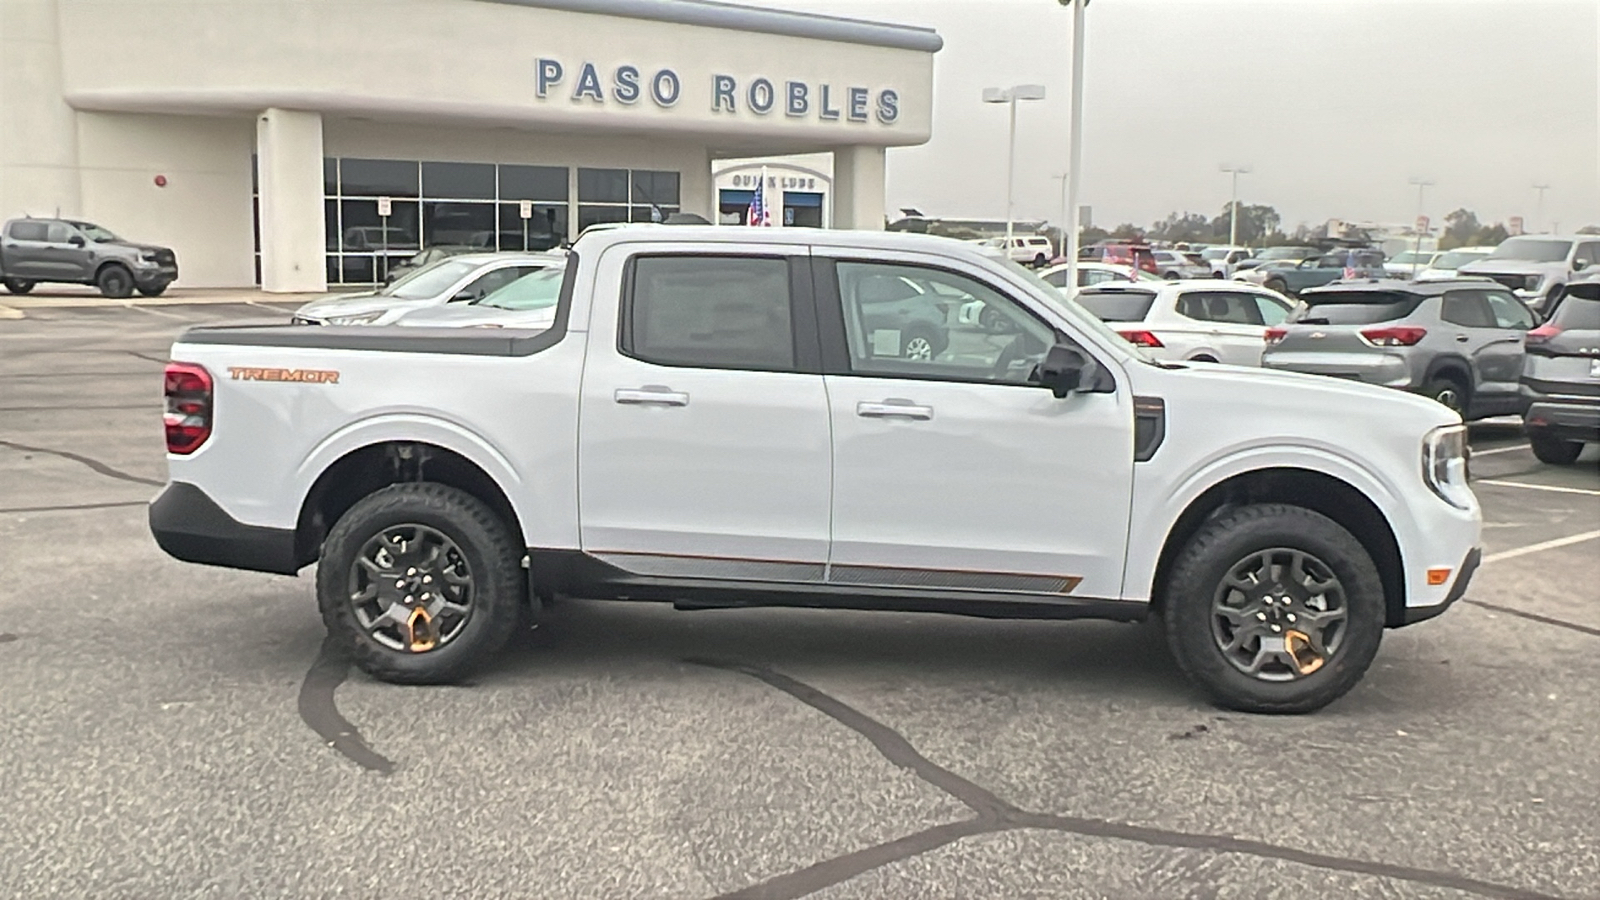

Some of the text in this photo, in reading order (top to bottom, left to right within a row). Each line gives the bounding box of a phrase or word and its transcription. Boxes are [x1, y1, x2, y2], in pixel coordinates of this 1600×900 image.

[535, 58, 899, 124] PASO ROBLES
[732, 174, 776, 188] QUIK
[227, 366, 340, 384] TREMOR
